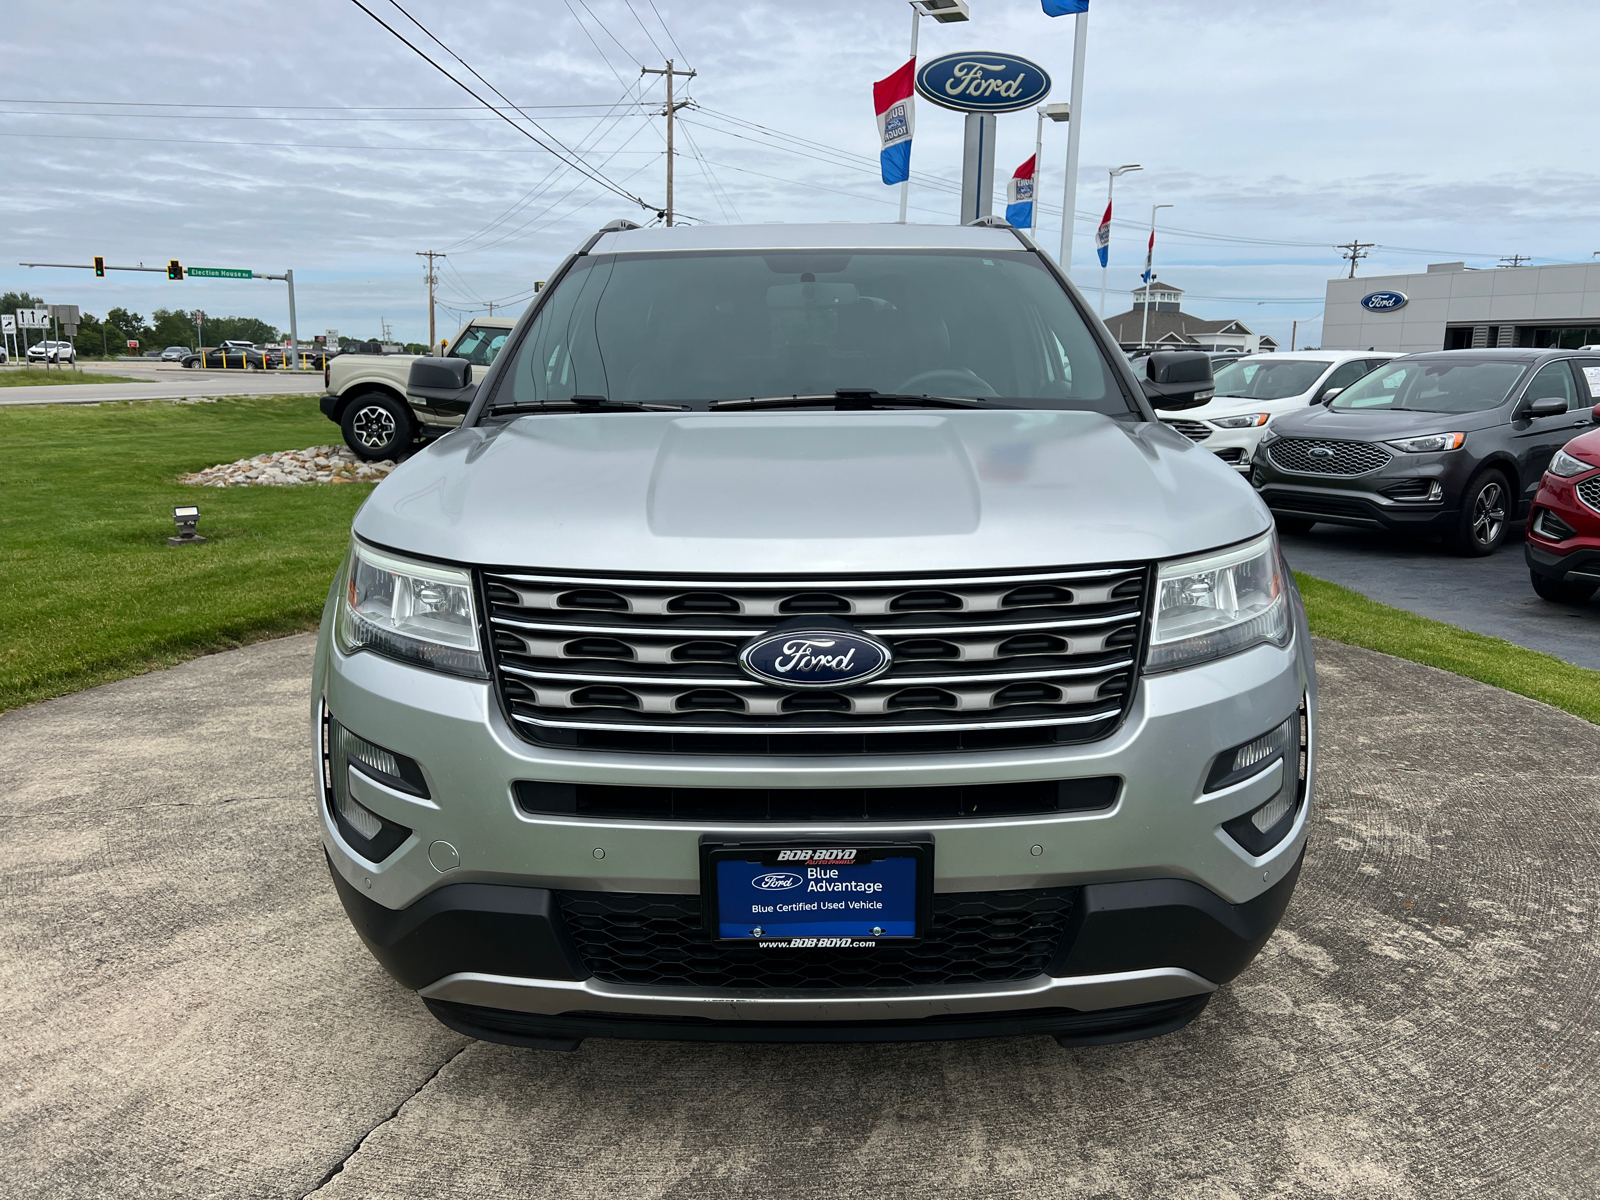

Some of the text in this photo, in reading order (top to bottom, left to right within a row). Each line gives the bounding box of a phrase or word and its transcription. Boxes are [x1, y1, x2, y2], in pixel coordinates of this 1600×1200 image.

[945, 62, 1026, 97] Ford
[1369, 295, 1395, 307] Ford
[774, 639, 856, 673] Ford
[807, 867, 839, 879] Blue
[761, 875, 793, 888] Ford
[807, 880, 883, 893] Advantage
[752, 901, 883, 913] Blue Certified Used Vehicle
